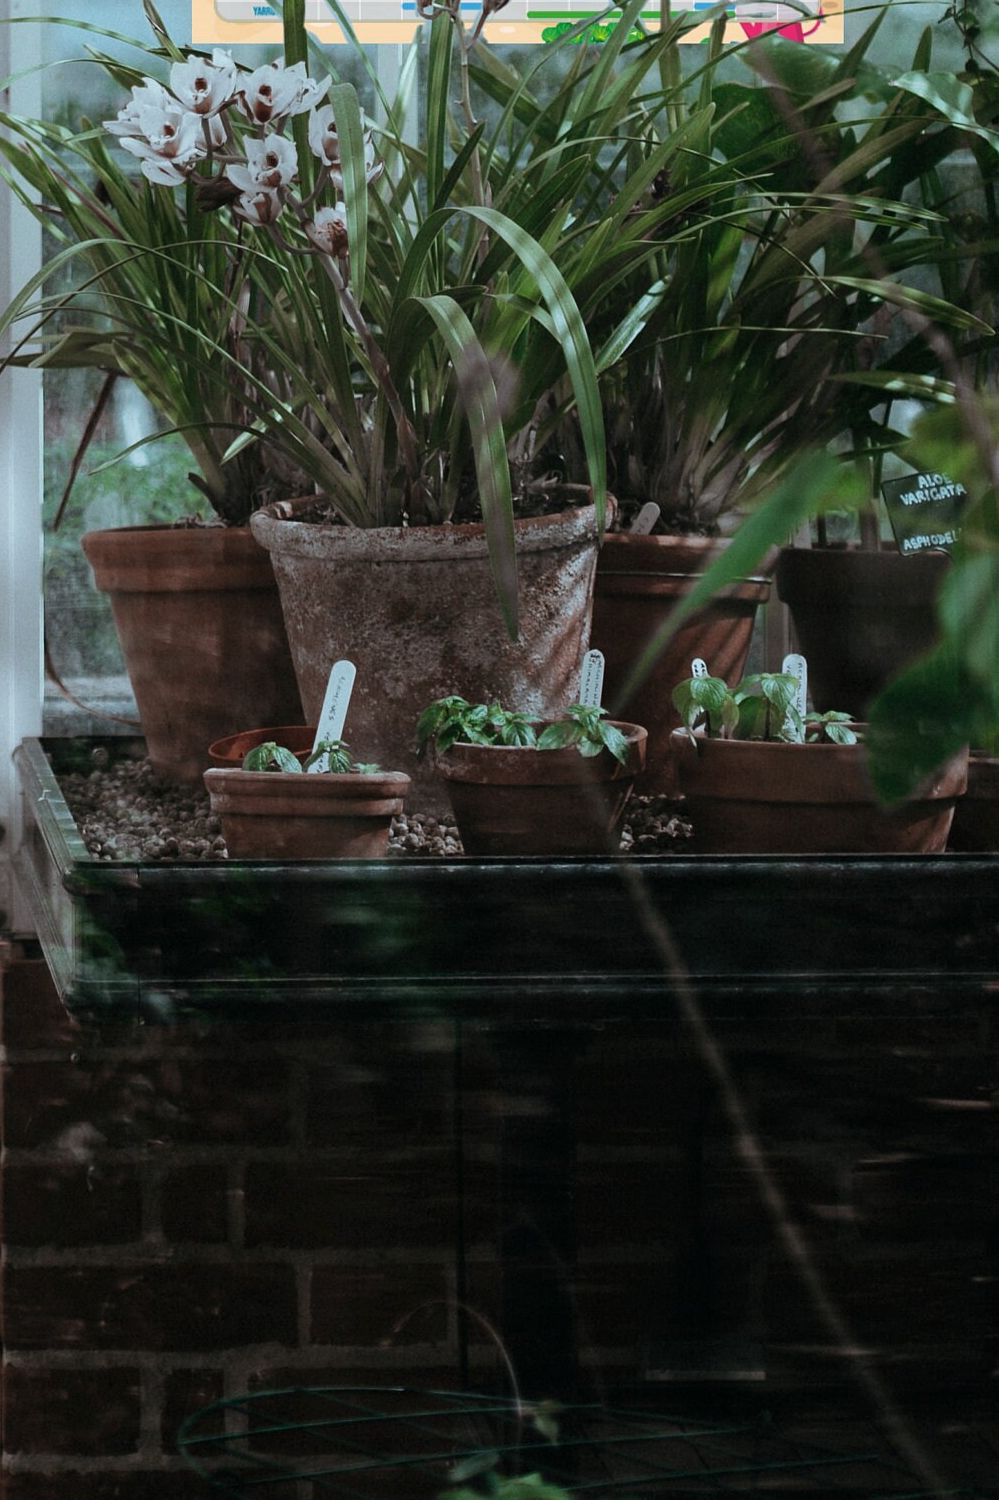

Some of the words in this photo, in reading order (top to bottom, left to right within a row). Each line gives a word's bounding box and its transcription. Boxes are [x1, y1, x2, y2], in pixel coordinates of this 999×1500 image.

[253, 6, 275, 16] YARR
[918, 473, 952, 488] ALOE
[900, 484, 967, 505] VARIGATA
[903, 529, 958, 550] ASPHODEL
